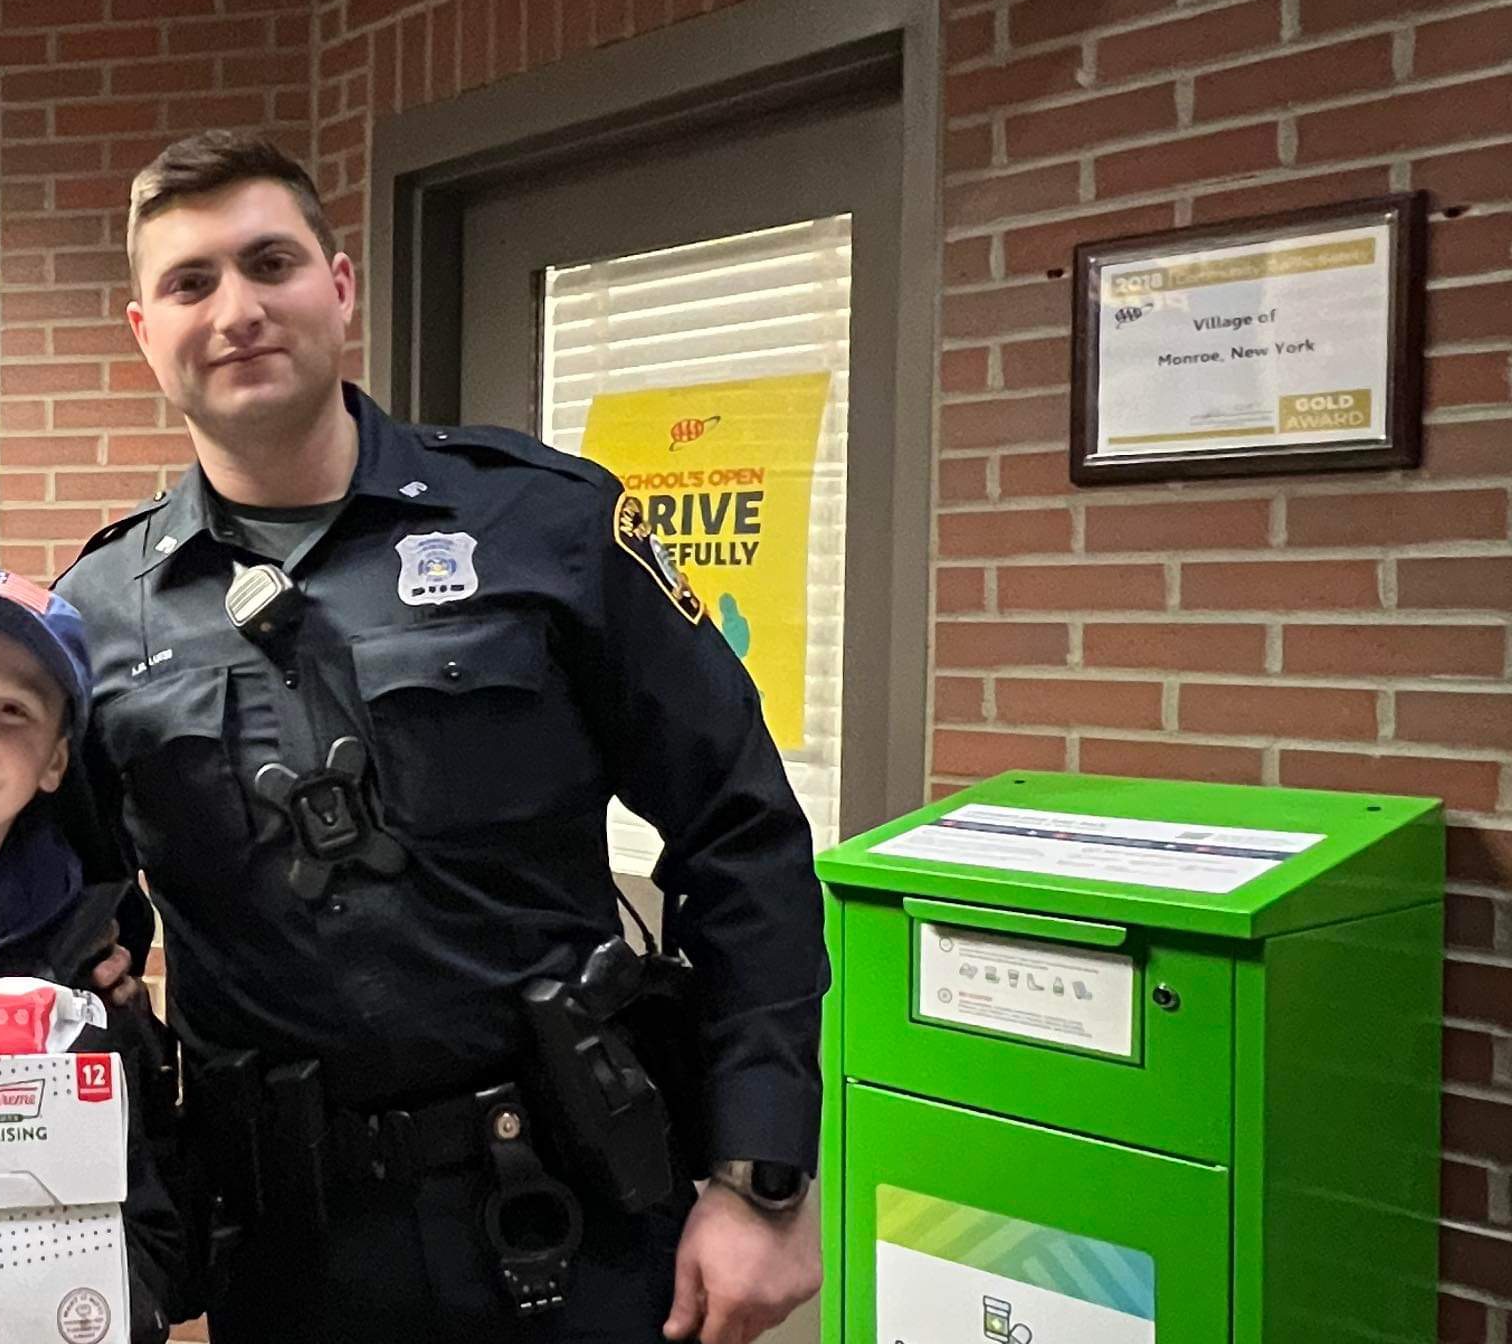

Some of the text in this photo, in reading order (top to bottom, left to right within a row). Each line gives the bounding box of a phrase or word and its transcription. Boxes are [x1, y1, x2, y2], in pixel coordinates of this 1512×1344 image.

[1115, 272, 1163, 294] 2018
[1193, 308, 1277, 331] Village of
[1231, 345, 1269, 359] New
[1275, 338, 1315, 355] York
[1295, 395, 1355, 412] GOLD
[1287, 410, 1365, 429] AWARD
[708, 467, 765, 486] OPEN
[644, 491, 765, 537] RIVE
[665, 541, 760, 567] EFULLY
[82, 1064, 106, 1086] 12
